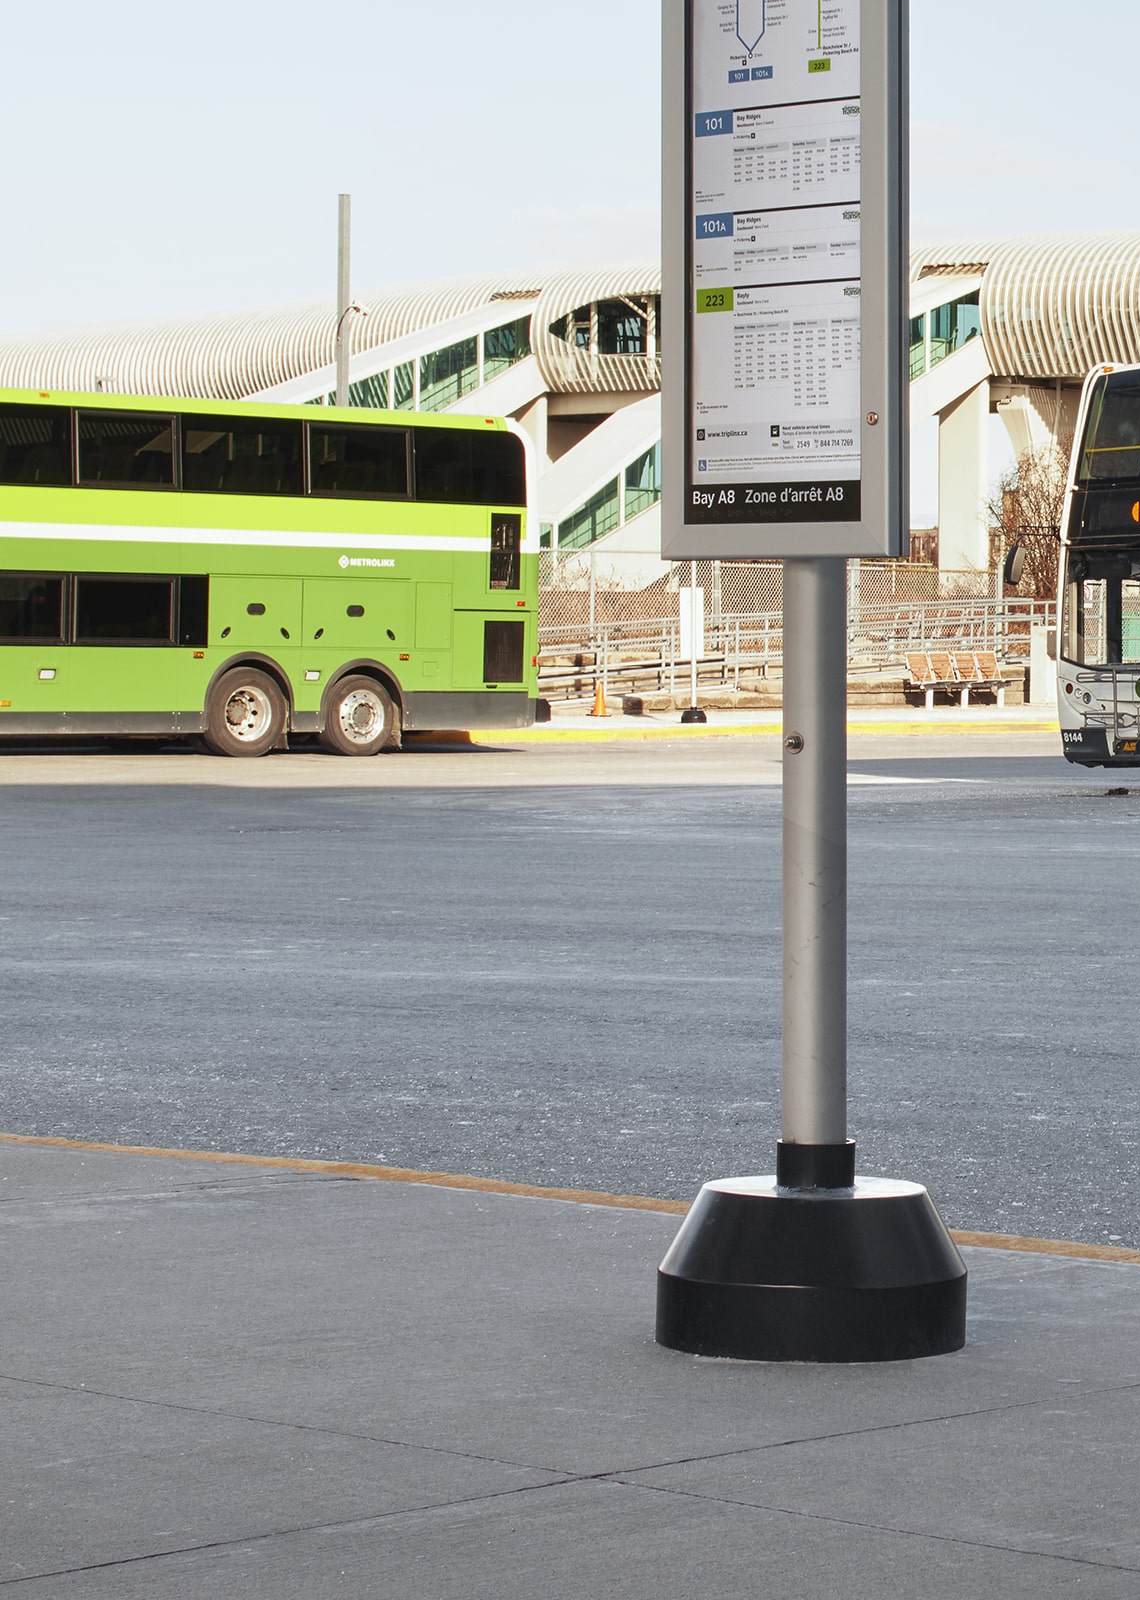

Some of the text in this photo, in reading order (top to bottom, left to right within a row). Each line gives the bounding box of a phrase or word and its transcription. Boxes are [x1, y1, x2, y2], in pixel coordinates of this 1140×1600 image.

[814, 62, 825, 70] 223
[705, 117, 723, 131] 101
[703, 220, 726, 233] 101A
[705, 294, 724, 307] 223
[707, 430, 747, 438] www.triplinx.ca
[797, 440, 810, 448] 2549
[693, 487, 844, 508] Bay A8 Zone d'arrêt A8
[350, 558, 396, 567] METROLINX
[1064, 732, 1083, 742] 8144
